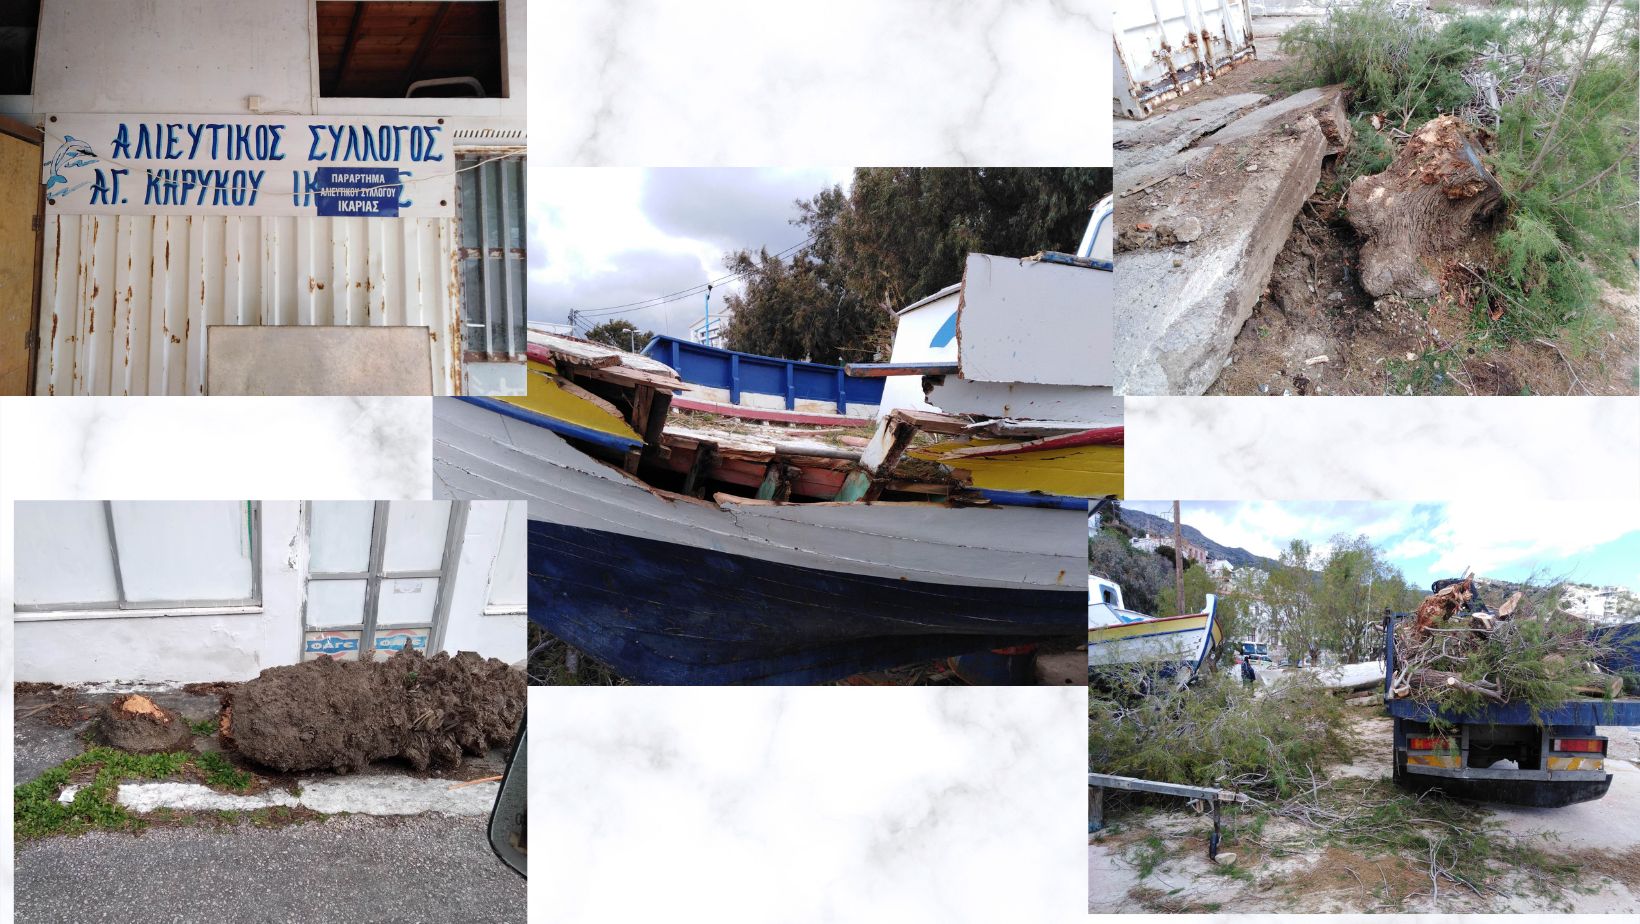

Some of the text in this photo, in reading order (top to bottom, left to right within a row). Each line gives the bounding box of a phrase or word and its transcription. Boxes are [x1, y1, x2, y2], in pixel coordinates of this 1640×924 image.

[111, 123, 444, 162] ΑΛΙΕΥΤΙΚΟΣ ΣΥΛΛΟΓΟΣ
[331, 173, 385, 183] ΠΑΡΑΡΤΗΜΑ
[89, 168, 129, 205] ΑΓ.
[144, 169, 266, 206] ΚΗΡΥΚΟΥ
[361, 187, 396, 197] ΣΥΛΛΟΓΟΥ
[338, 201, 379, 212] ΙΚΑΡΙΑΣ
